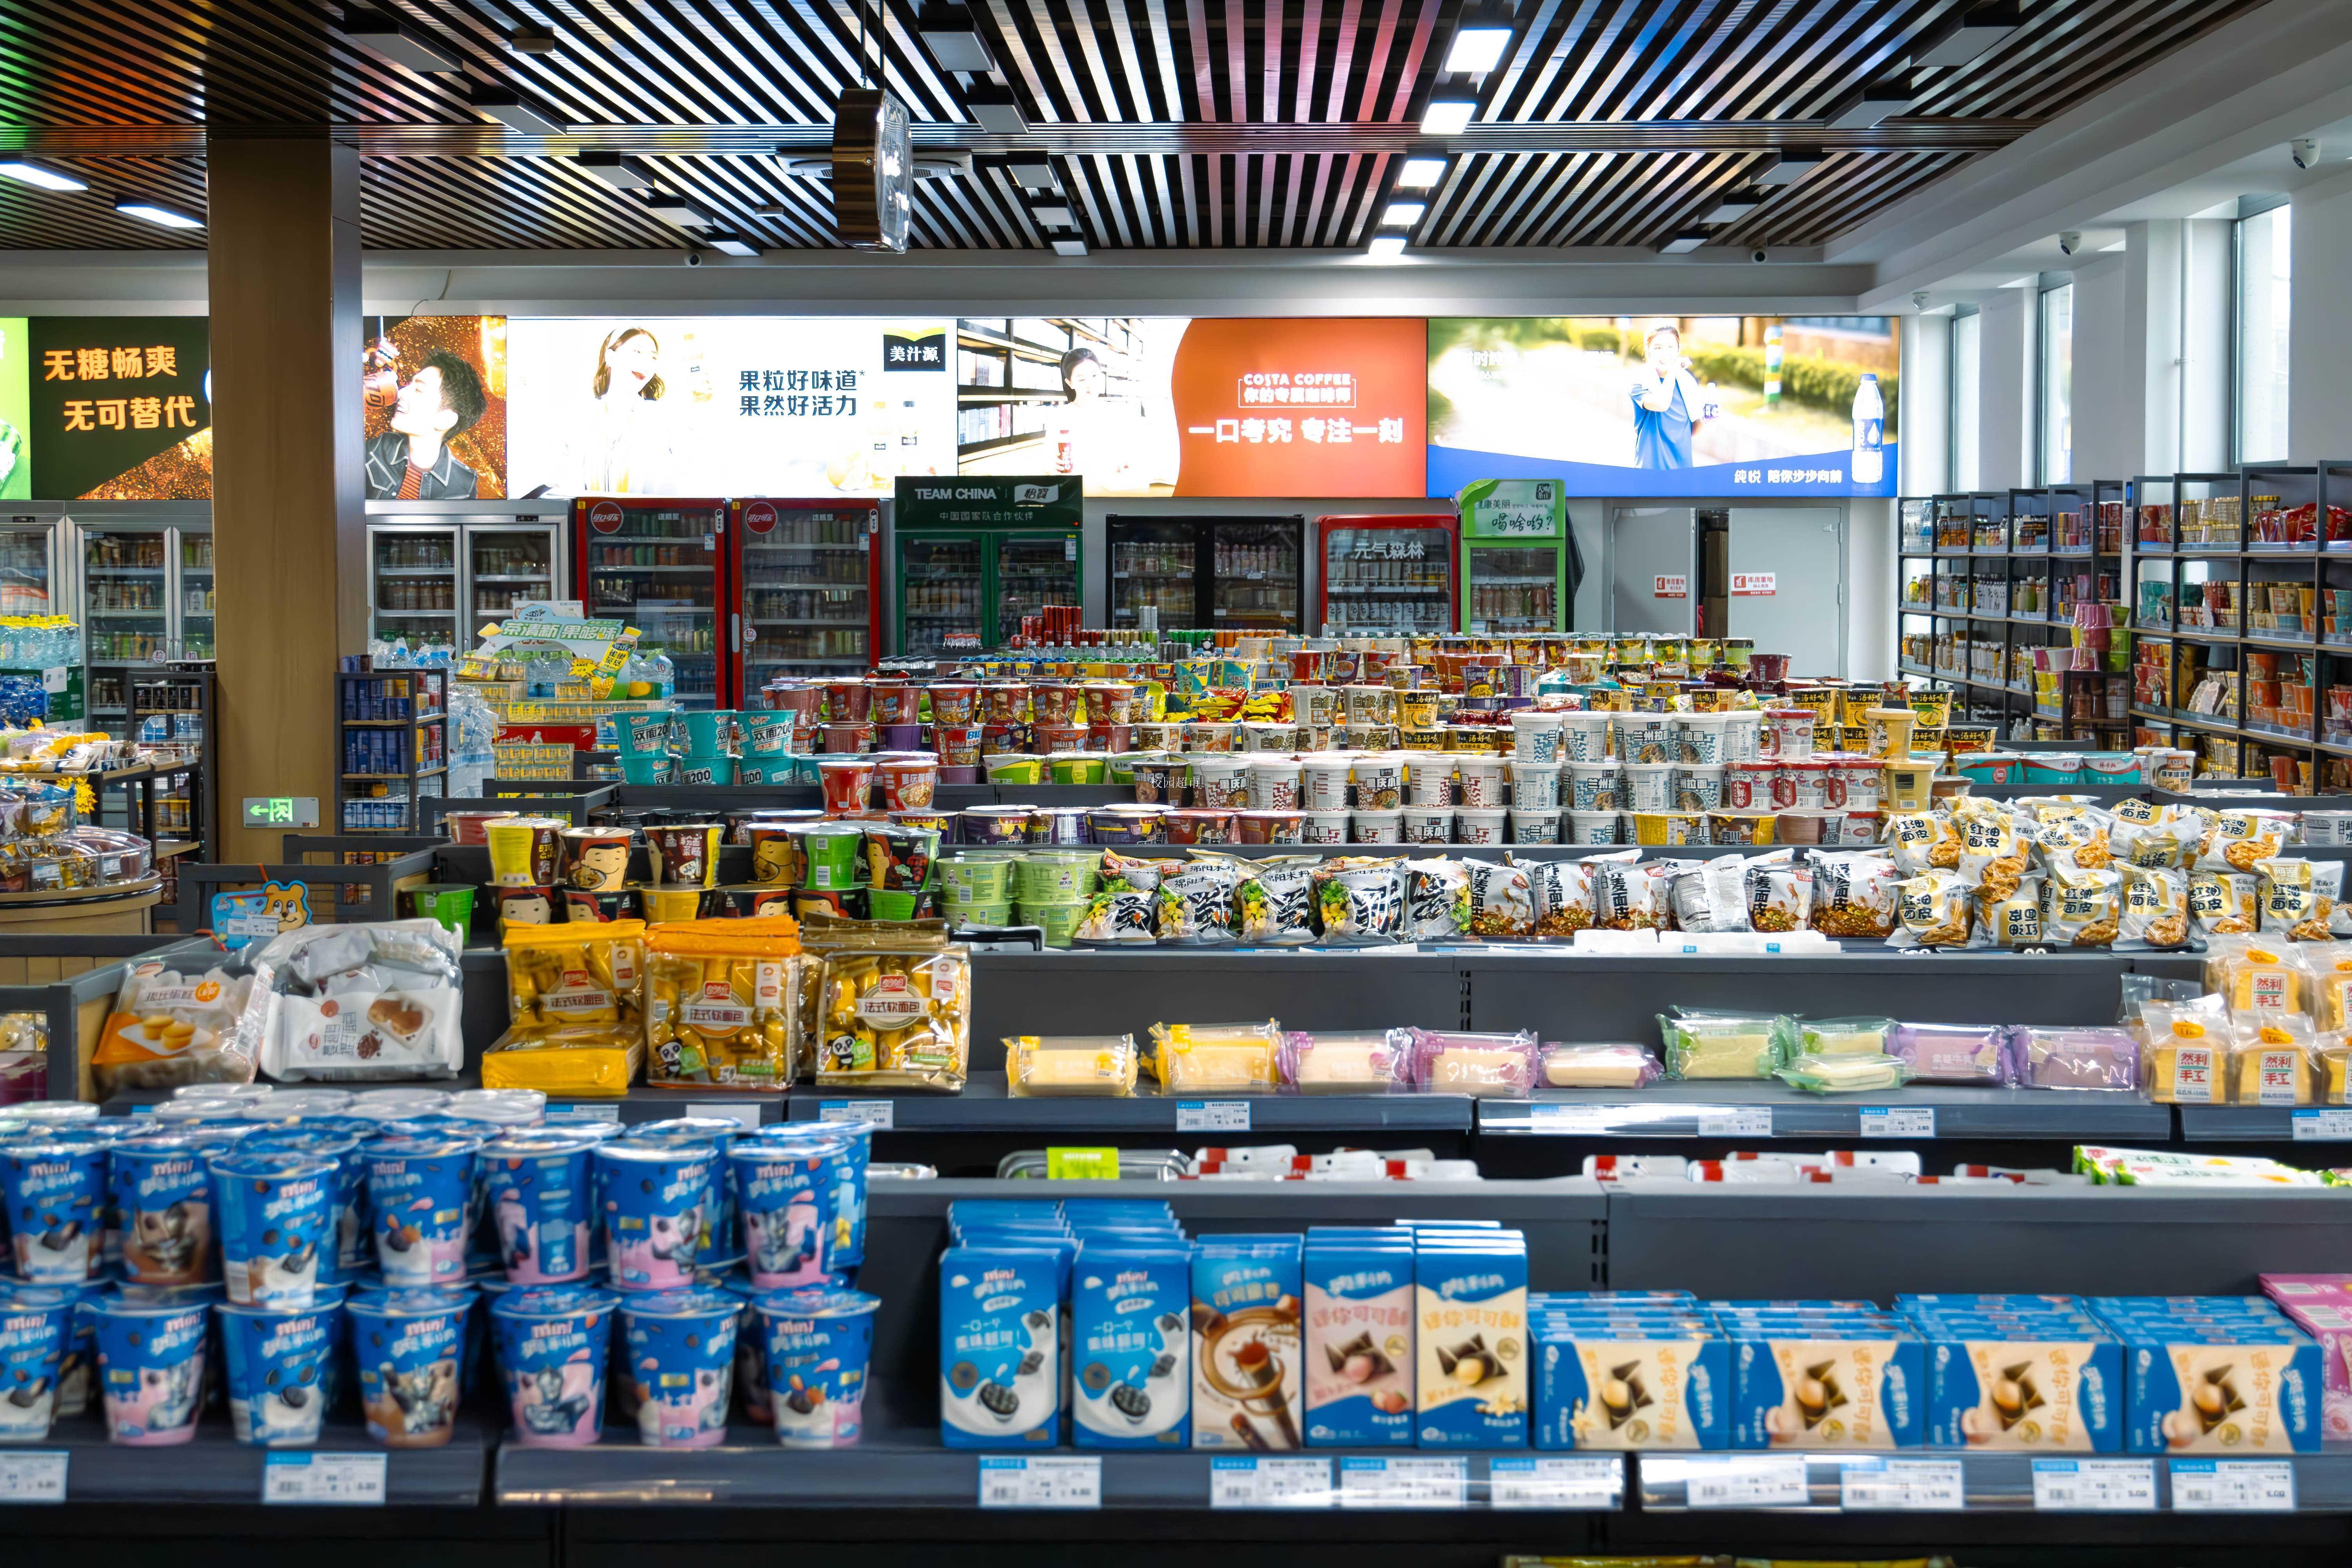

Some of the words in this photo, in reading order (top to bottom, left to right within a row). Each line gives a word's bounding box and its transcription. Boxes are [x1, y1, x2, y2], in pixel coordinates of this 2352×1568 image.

[890, 346, 938, 362] 美汁源
[44, 345, 178, 381] 无糖畅爽
[739, 370, 857, 391] 果粒好味道
[1243, 374, 1290, 386] COSTA
[1294, 374, 1351, 385] COFFEE
[1244, 387, 1351, 403] 你的专属咖啡师
[739, 395, 857, 416] 果然好活力
[63, 396, 196, 431] 无可替代
[1189, 417, 1292, 443] 一口考究
[1301, 417, 1403, 443] 专注一刻
[1734, 470, 1761, 484] 纯悦
[1768, 470, 1842, 484] 陪你步步向前
[915, 489, 952, 499] TEAM
[956, 488, 996, 499] CHINA
[940, 512, 1034, 521] 中国国家队合作伙伴
[1355, 541, 1425, 559] 元气森林
[502, 622, 561, 638] 茶清新
[562, 624, 622, 641] 果够味
[633, 723, 668, 744] 双面20
[1219, 777, 1250, 789] 重庆小
[1413, 825, 1450, 837] 重庆小
[1969, 823, 2000, 837] 红油
[1968, 835, 1999, 849] 面皮
[2065, 887, 2093, 899] 红油
[2272, 883, 2301, 897] 红油
[2063, 902, 2093, 914] 面皮
[2271, 897, 2301, 911] 面皮
[865, 1001, 920, 1013] 法式软面包
[2256, 995, 2282, 1008] 手工
[2180, 1052, 2208, 1065] 然利
[2265, 1055, 2292, 1068] 然利
[2179, 1070, 2206, 1083] 手工
[2264, 1072, 2291, 1085] 手工
